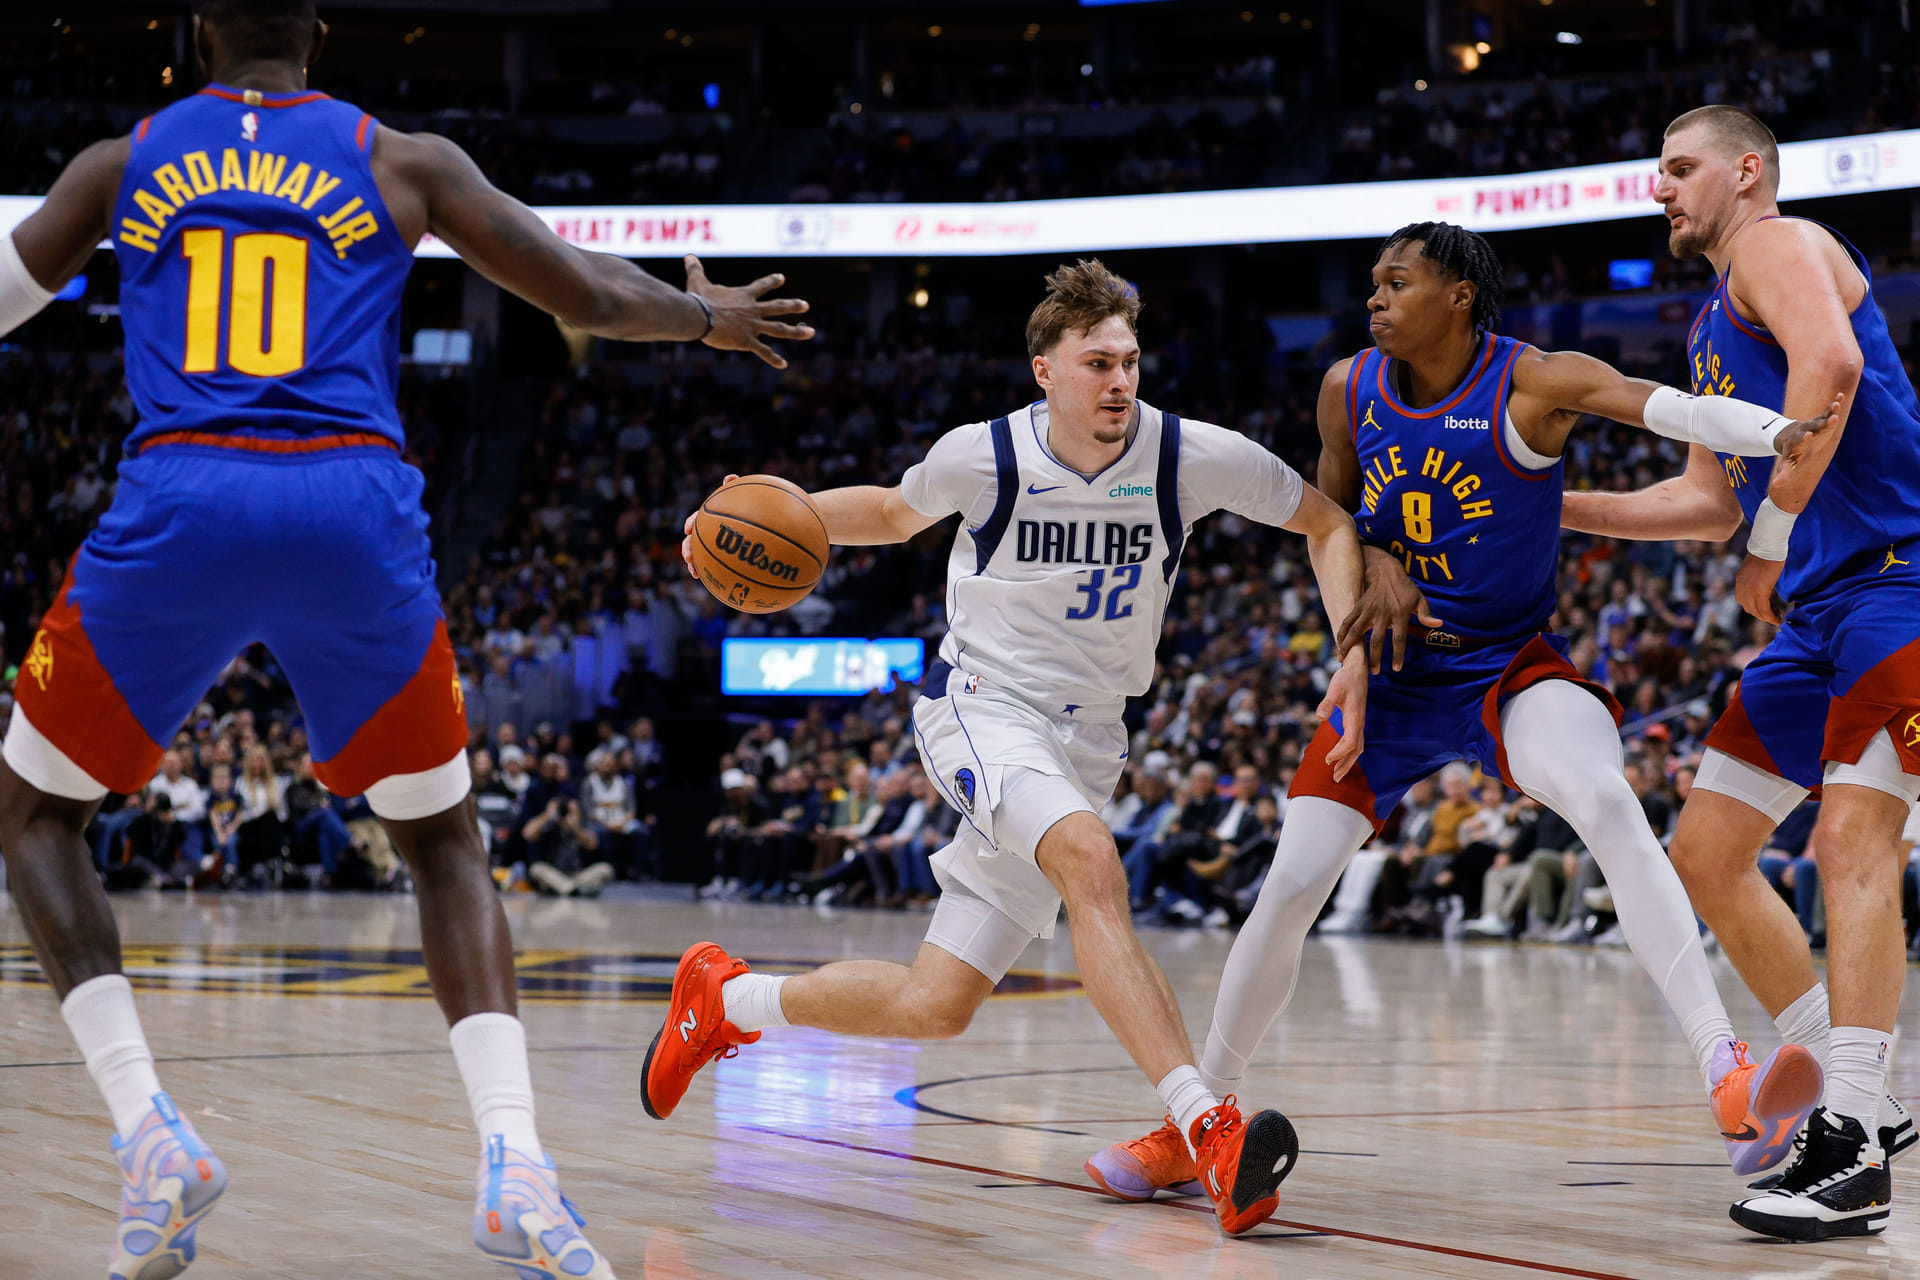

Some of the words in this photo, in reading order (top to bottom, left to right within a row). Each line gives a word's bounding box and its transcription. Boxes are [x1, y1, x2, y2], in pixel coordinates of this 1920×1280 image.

[119, 148, 341, 253] HARDAWAY
[317, 196, 379, 260] JR.
[181, 227, 309, 377] 10
[1444, 416, 1489, 430] ibotta
[1109, 484, 1153, 498] chime
[1363, 445, 1408, 515] MILE
[1421, 446, 1494, 520] HIGH
[1016, 519, 1153, 565] DALLAS
[1401, 491, 1432, 544] 8
[715, 523, 800, 582] Wilson
[1065, 564, 1142, 622] 32
